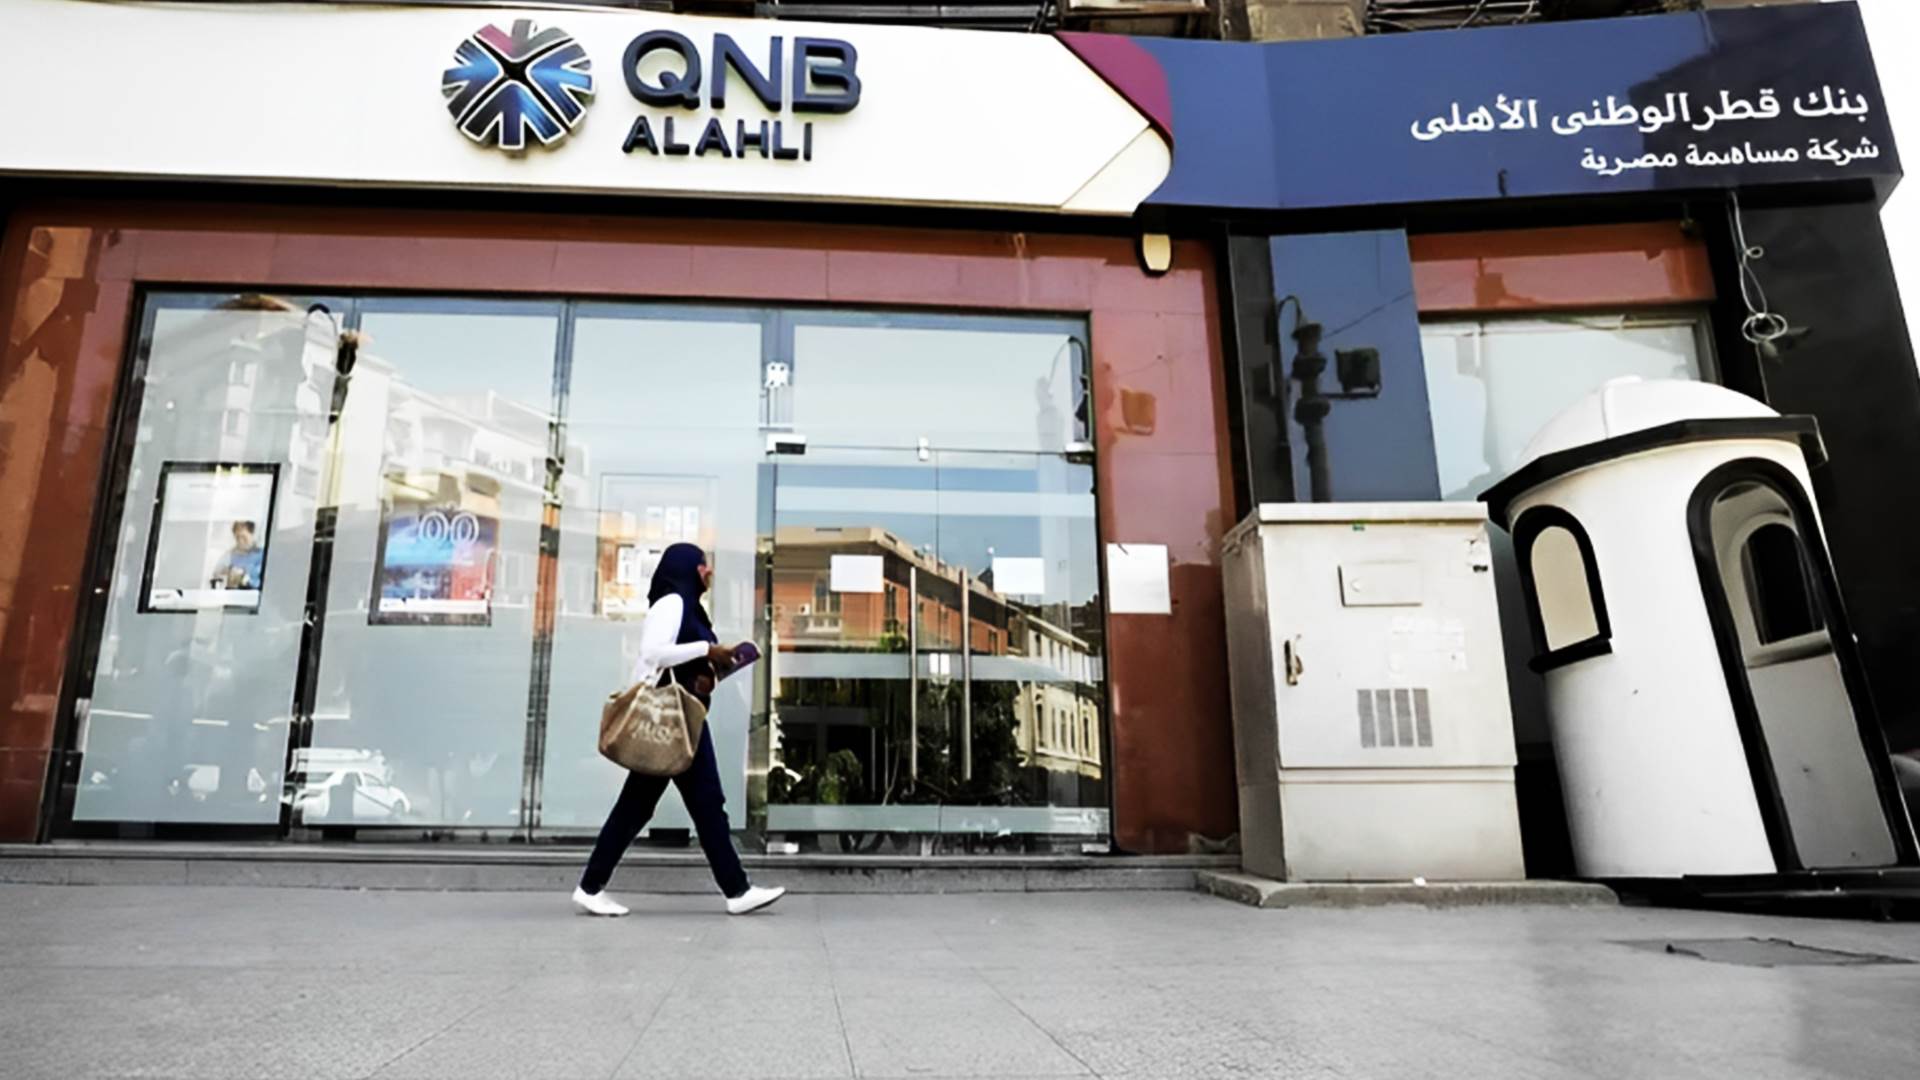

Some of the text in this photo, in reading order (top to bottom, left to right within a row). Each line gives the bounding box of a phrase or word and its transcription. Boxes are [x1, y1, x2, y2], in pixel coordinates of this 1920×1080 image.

[622, 29, 863, 114] QNB
[622, 115, 813, 161] ALAHLI
[1411, 84, 1869, 141] بنك قطر الوطنى الأهلى
[1580, 136, 1879, 176] شركة مساهمة مصرية
